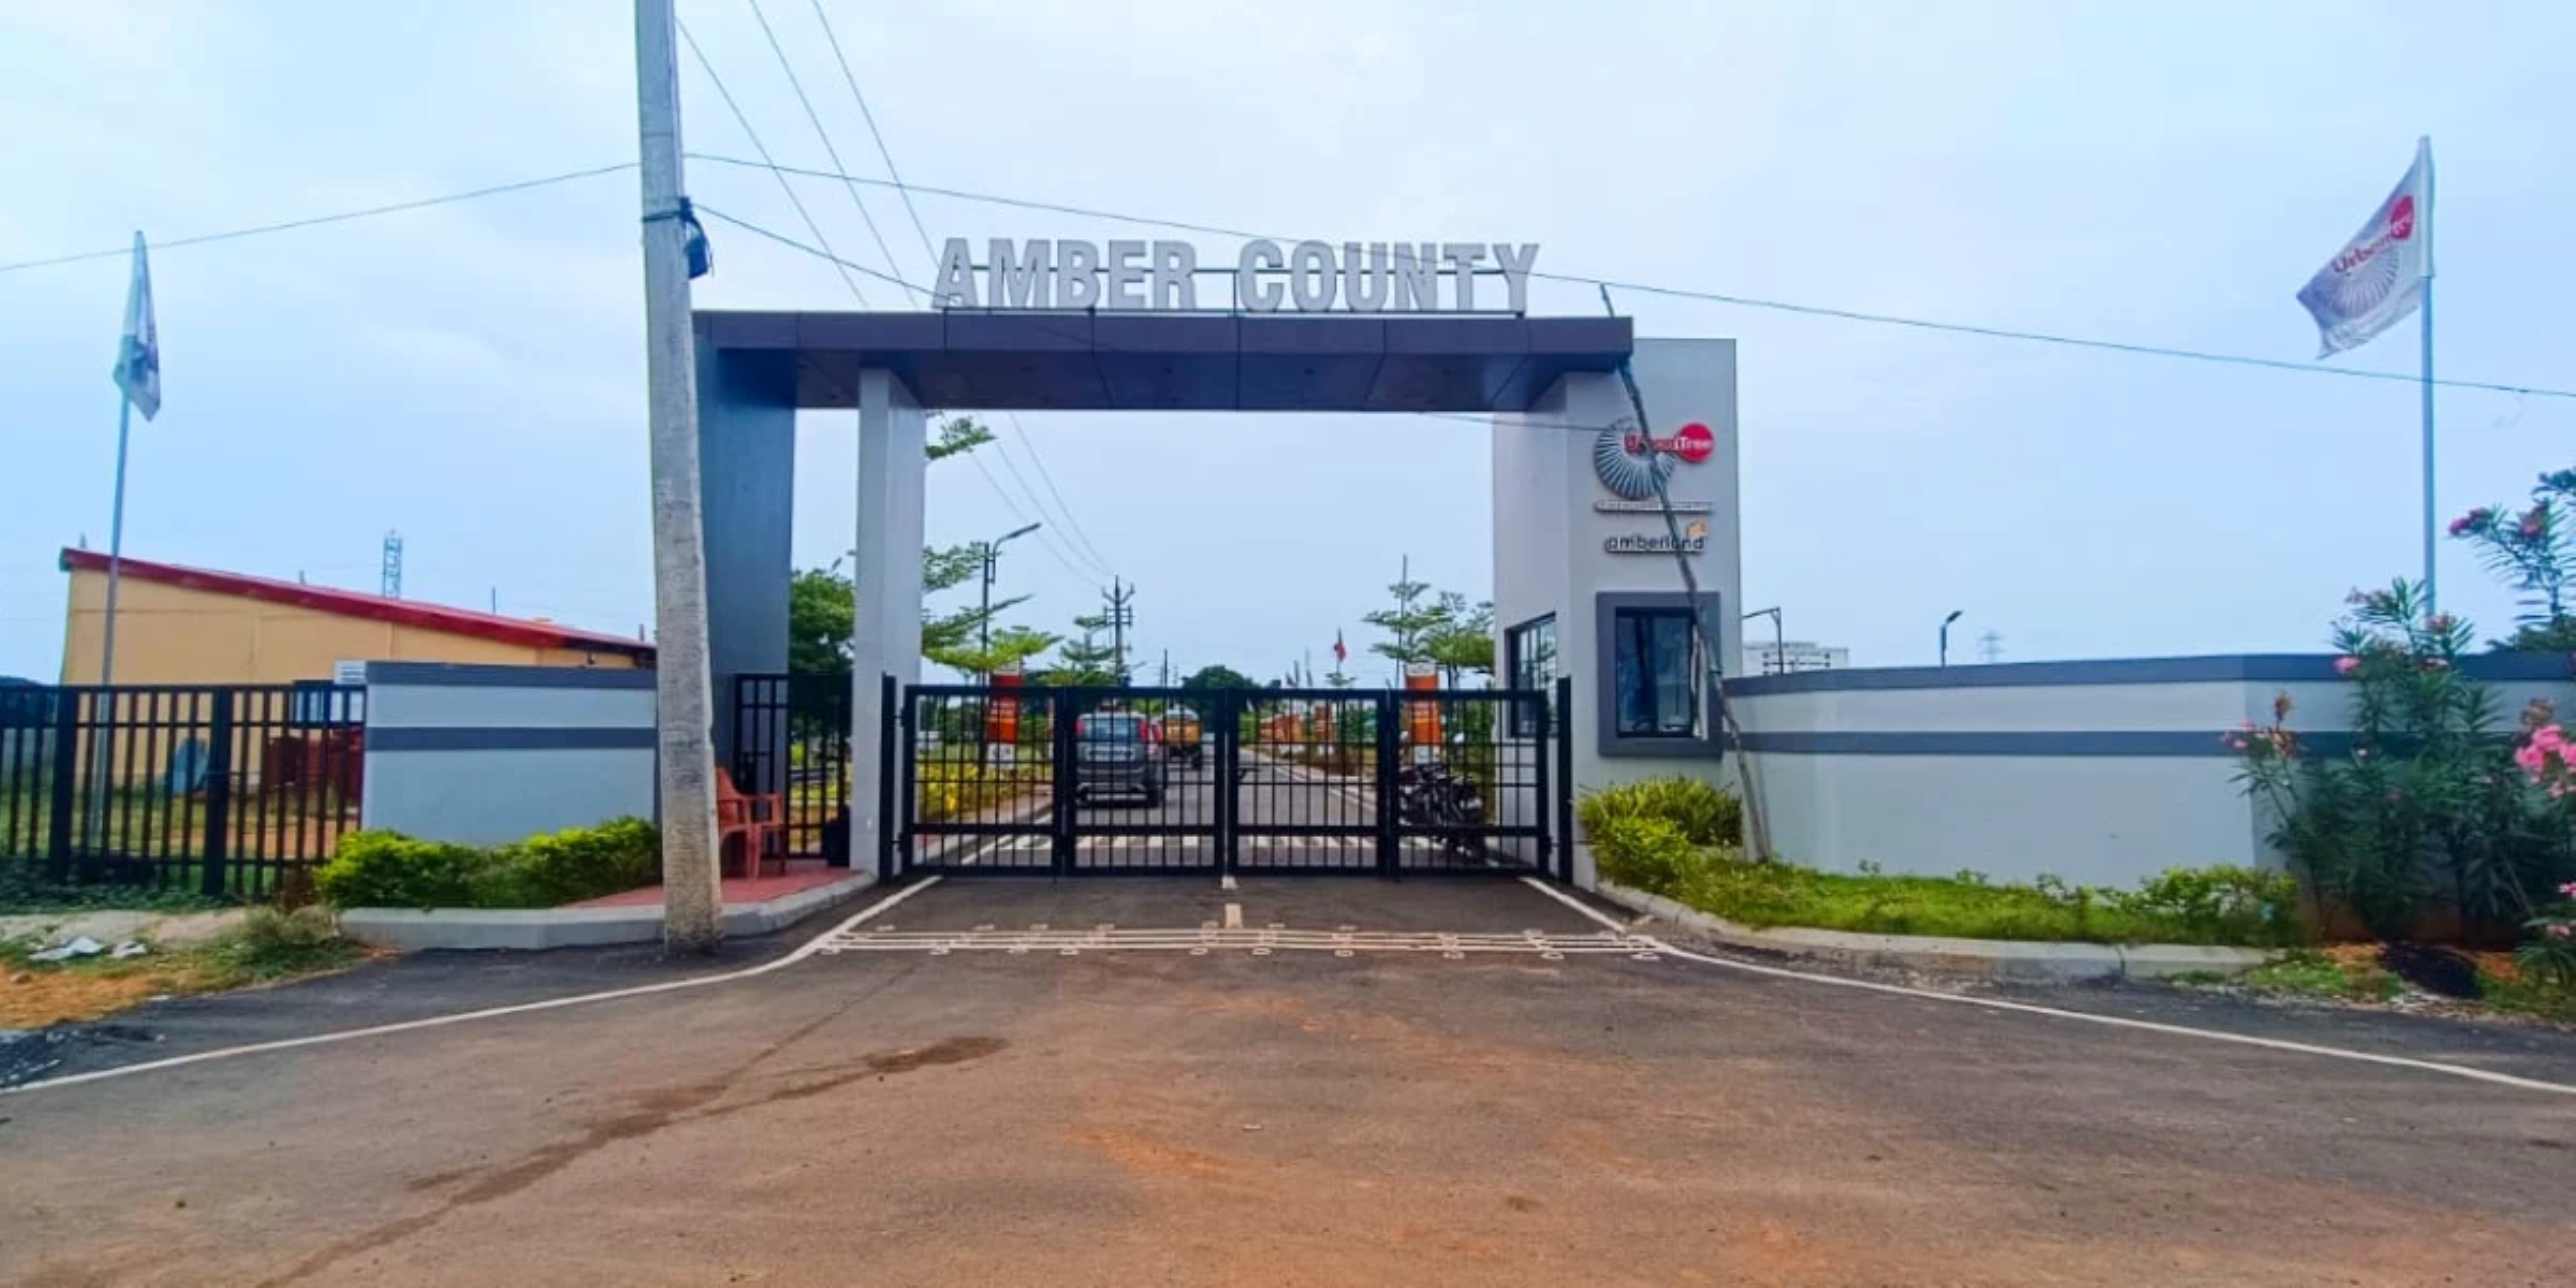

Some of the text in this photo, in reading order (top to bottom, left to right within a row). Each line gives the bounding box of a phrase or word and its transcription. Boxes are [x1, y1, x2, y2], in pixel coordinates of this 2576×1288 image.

[931, 237, 1540, 313] AMBER COUNTY
[1624, 433, 1711, 452] UanTree
